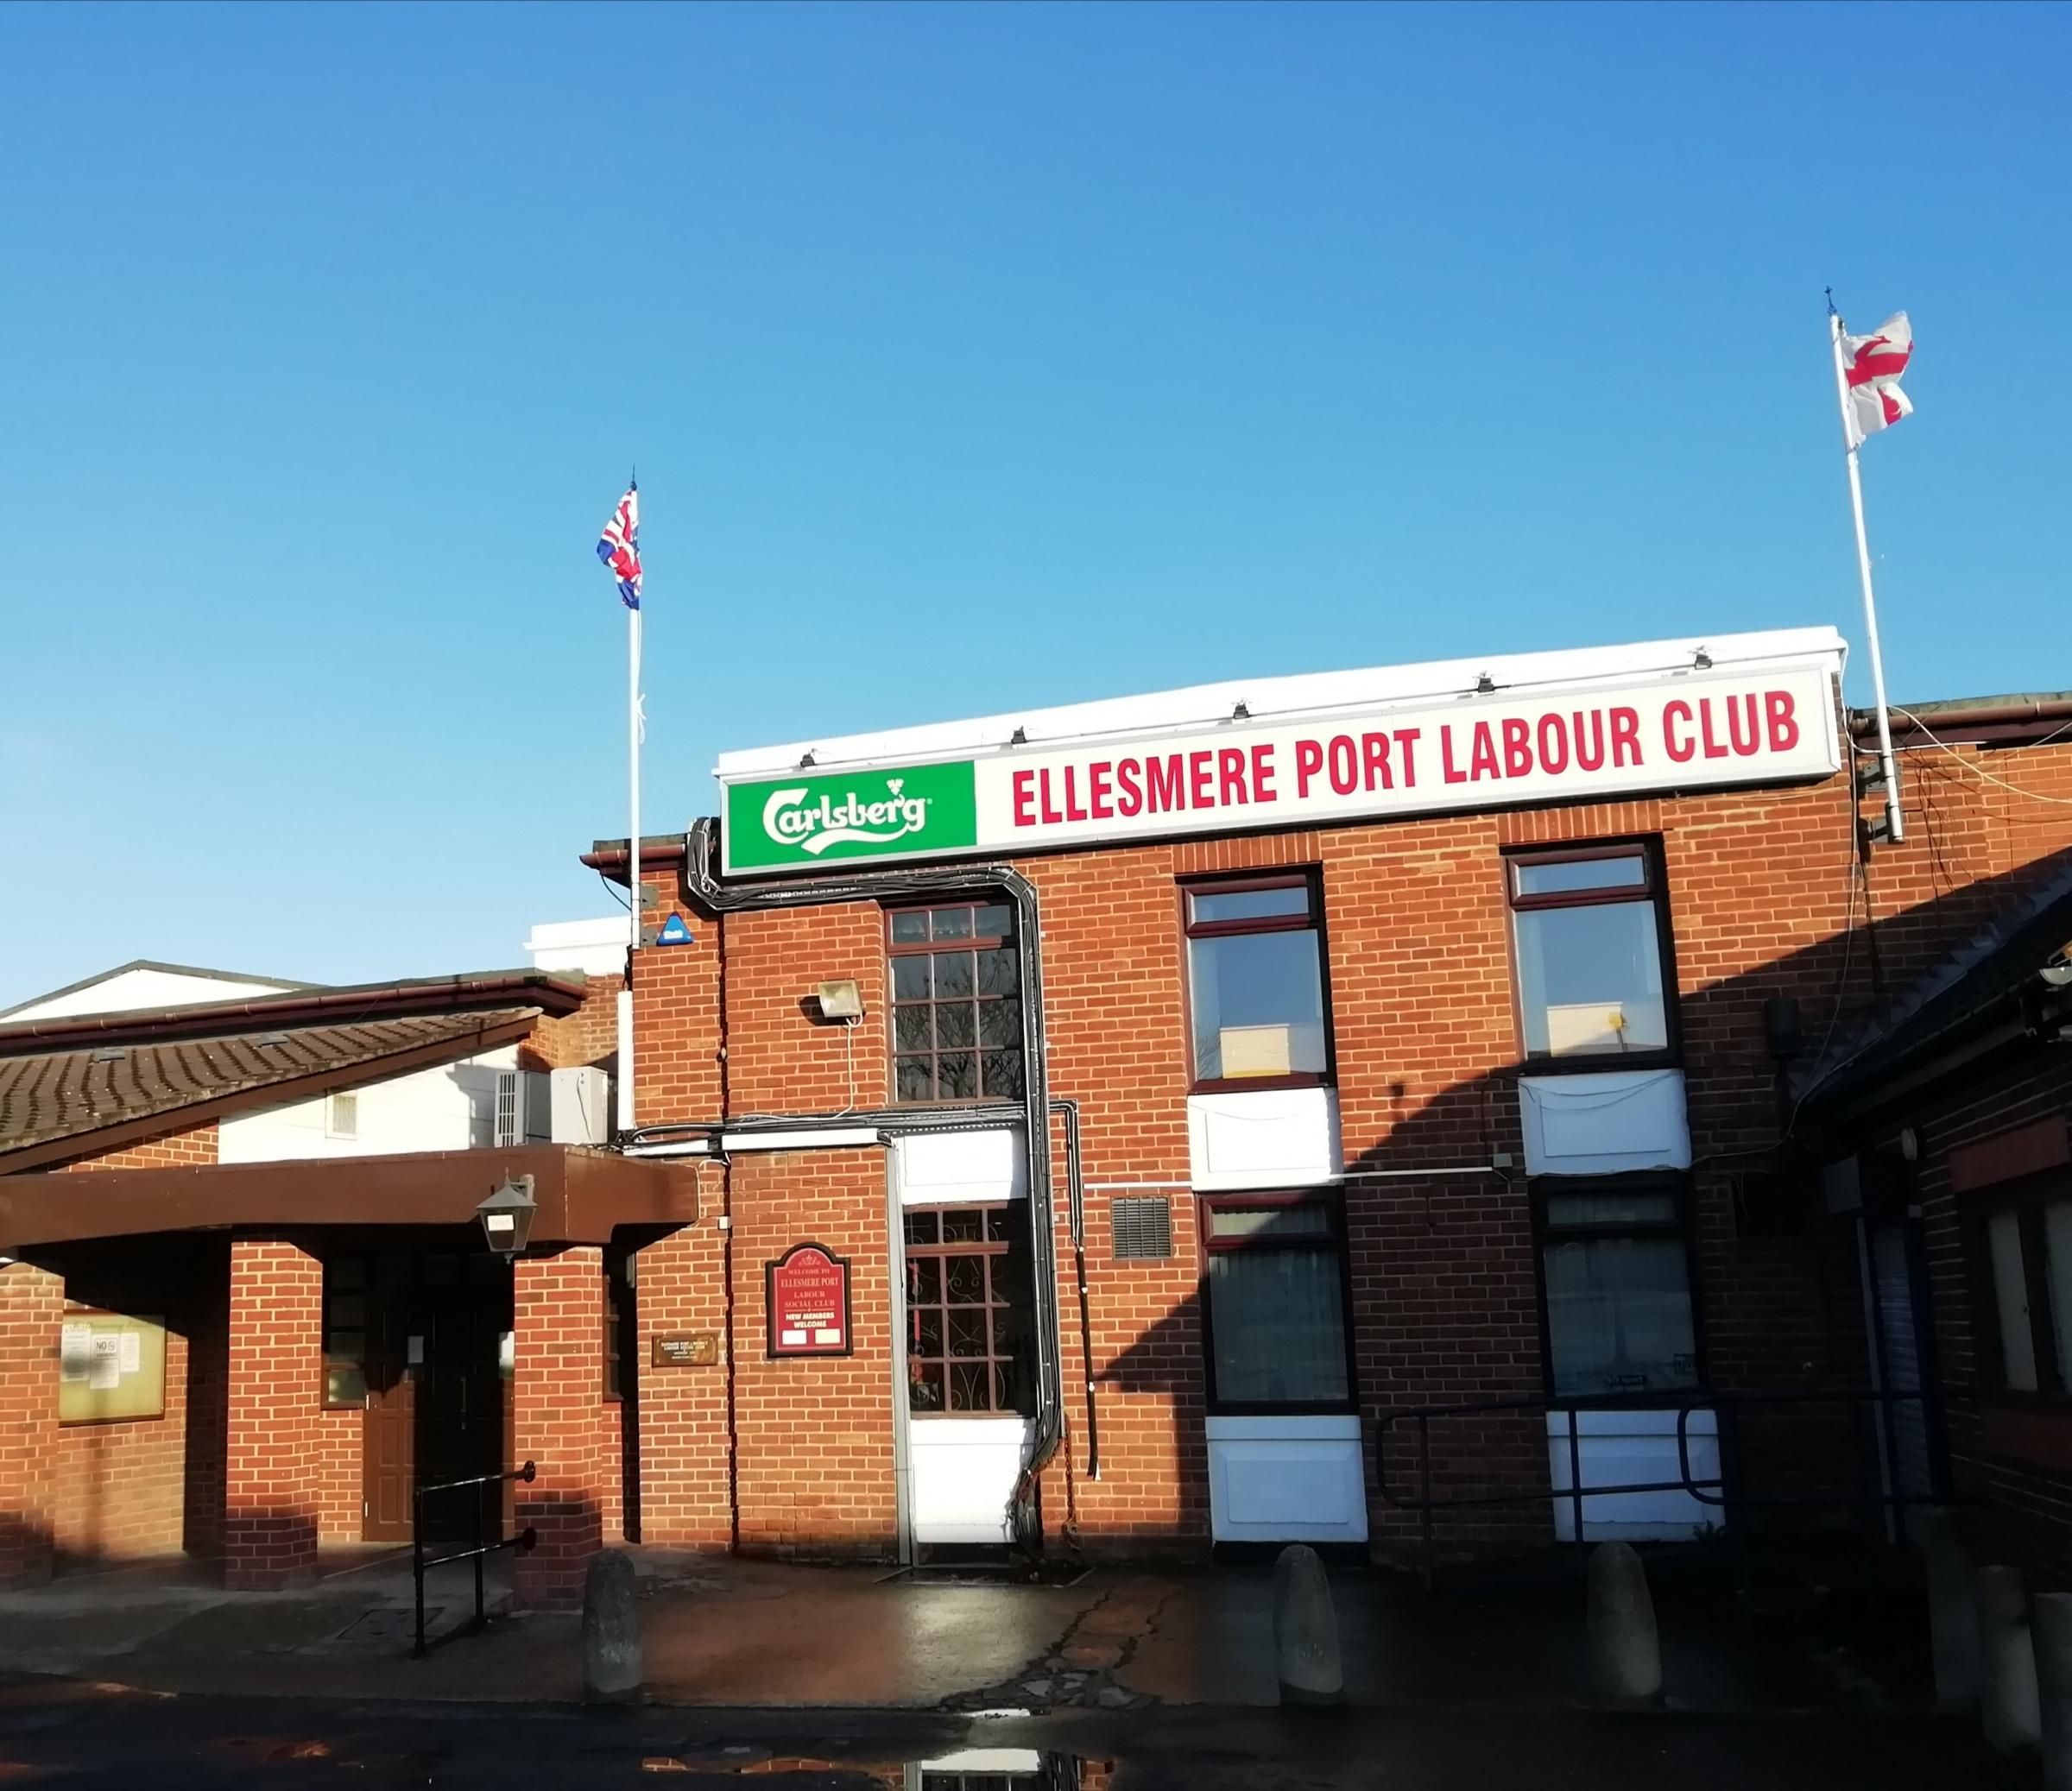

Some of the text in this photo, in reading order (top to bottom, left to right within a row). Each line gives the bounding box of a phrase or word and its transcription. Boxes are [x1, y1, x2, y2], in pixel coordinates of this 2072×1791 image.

[1013, 691, 1798, 827] ELLESMERE PORT LABOUR CLUB
[762, 787, 926, 850] Carlsberg
[780, 1277, 838, 1288] ELLESMERE PORT
[96, 1340, 107, 1350] NO
